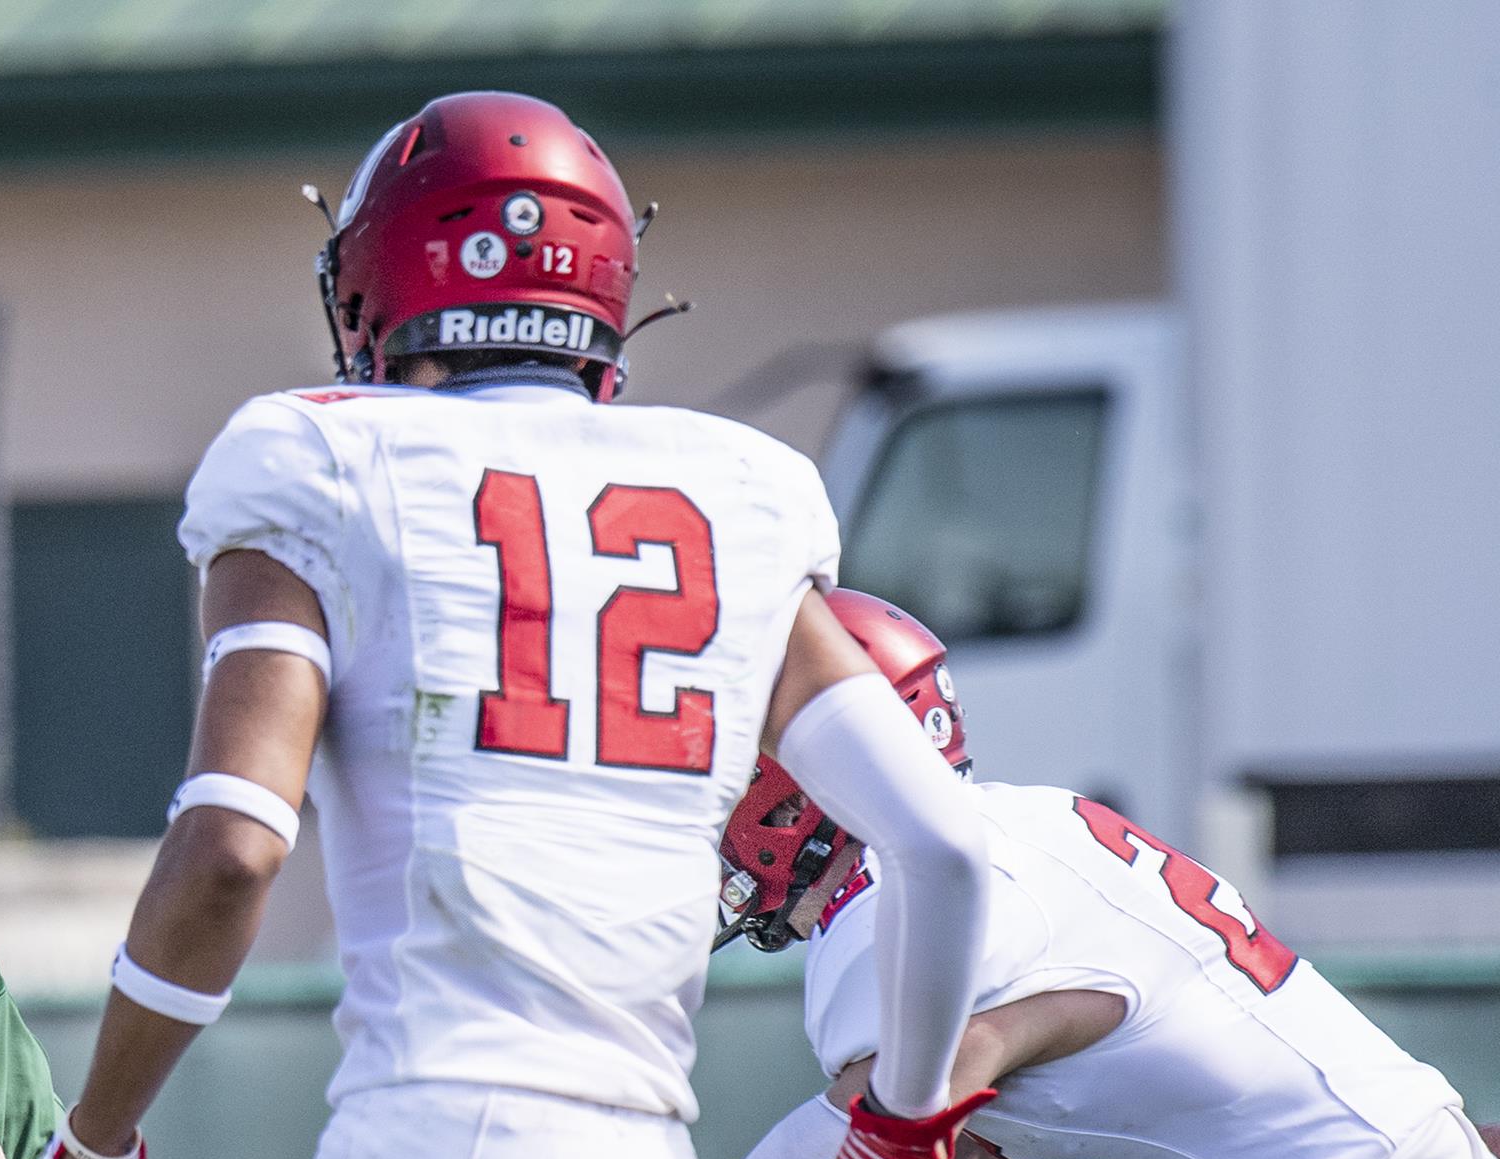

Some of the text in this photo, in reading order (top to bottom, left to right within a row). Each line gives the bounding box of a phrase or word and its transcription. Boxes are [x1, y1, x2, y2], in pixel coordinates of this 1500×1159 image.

[542, 245, 573, 275] 12
[439, 308, 595, 351] Riddell
[472, 467, 720, 777] 12
